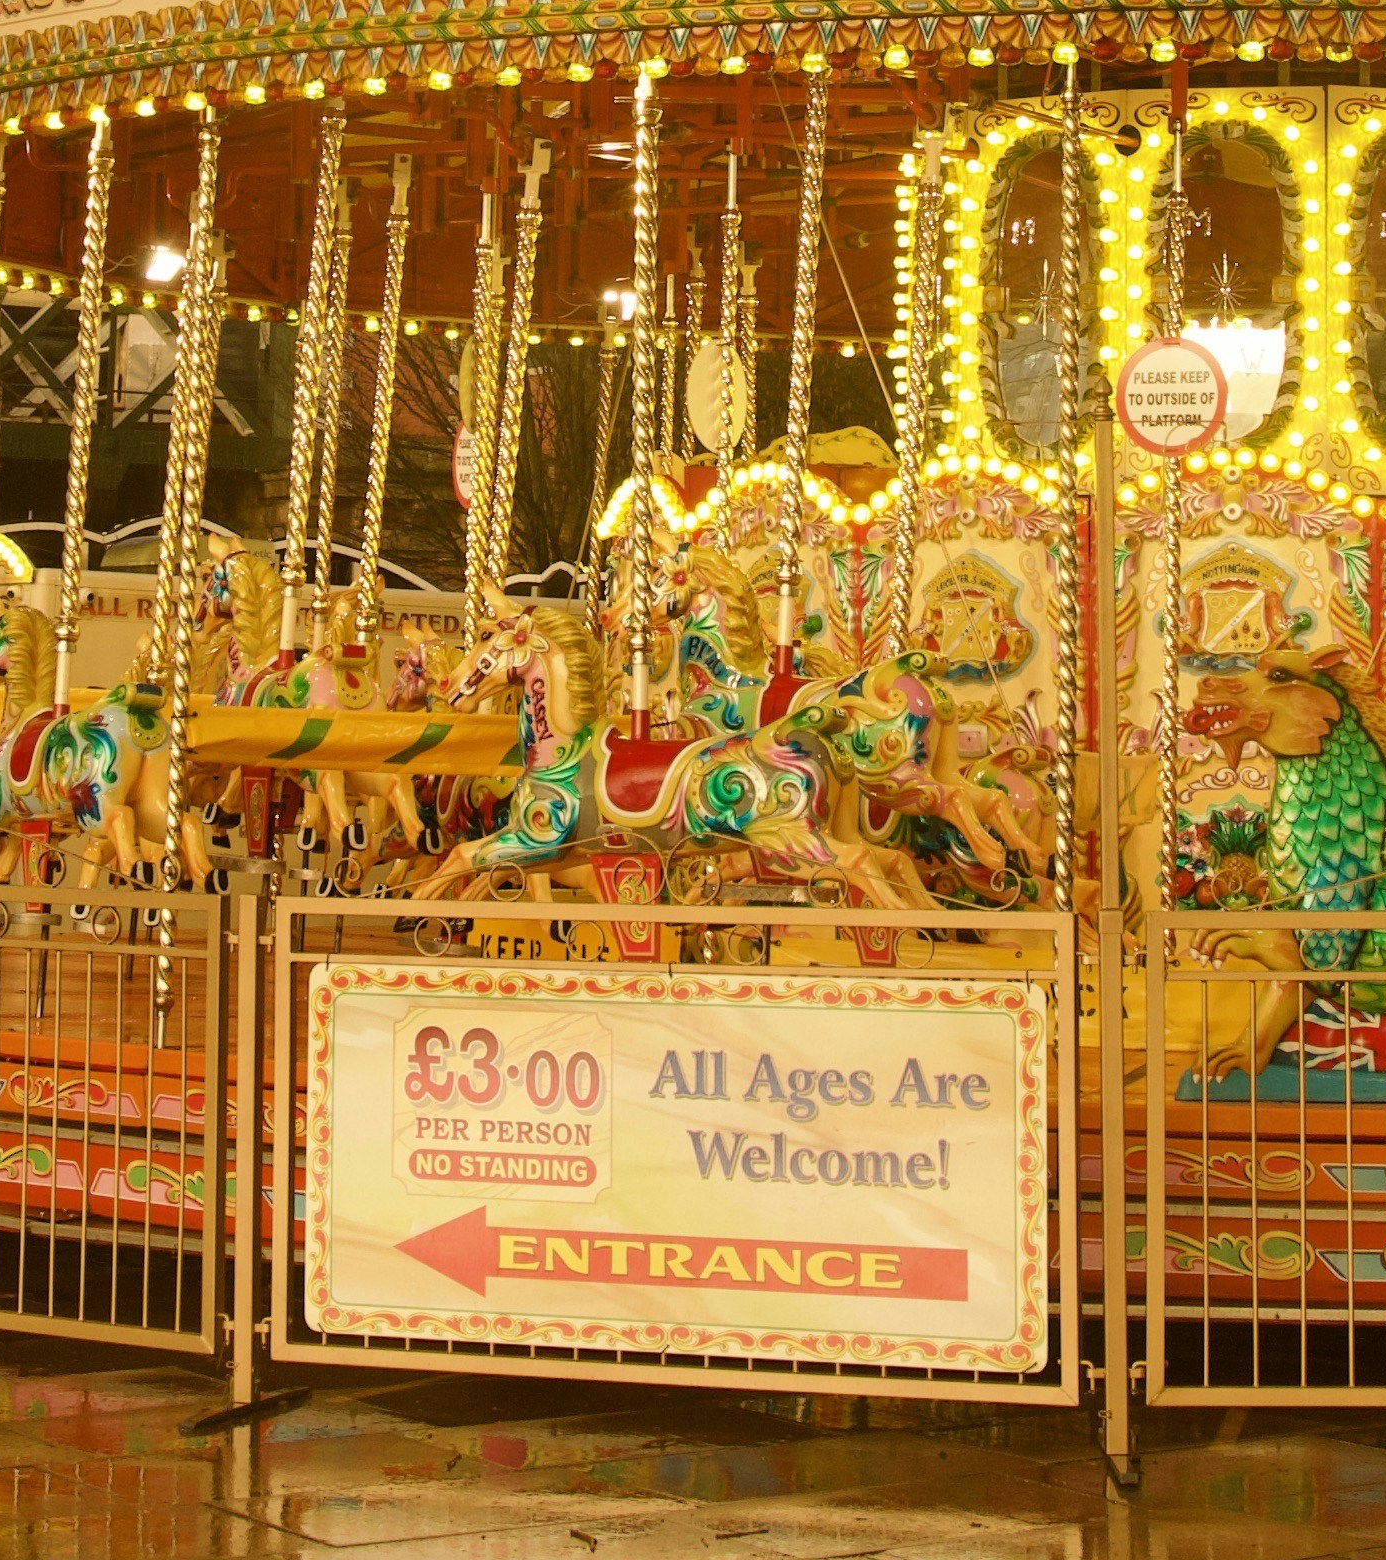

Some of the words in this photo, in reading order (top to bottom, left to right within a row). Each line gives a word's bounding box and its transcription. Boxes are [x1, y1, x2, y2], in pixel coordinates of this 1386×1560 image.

[1133, 371, 1177, 385] PLEASE
[1179, 370, 1210, 384] KEEP
[1128, 393, 1144, 406] TO
[1146, 393, 1196, 406] OUTSIDE
[1200, 392, 1215, 405] OF
[1141, 414, 1202, 428] PLATFORM
[1201, 563, 1261, 581] NOTTINGHAM
[380, 611, 460, 635] EATED
[530, 677, 554, 742] CASEY
[648, 1048, 730, 1102] All
[743, 1052, 874, 1122] Ages
[889, 1057, 991, 1111] Are
[415, 1116, 471, 1142] PER
[479, 1119, 593, 1147] PERSON
[415, 1153, 452, 1176] NO
[459, 1155, 589, 1183] STANDING
[686, 1129, 950, 1191] Welcome!
[497, 1234, 905, 1290] ENTRANCE
